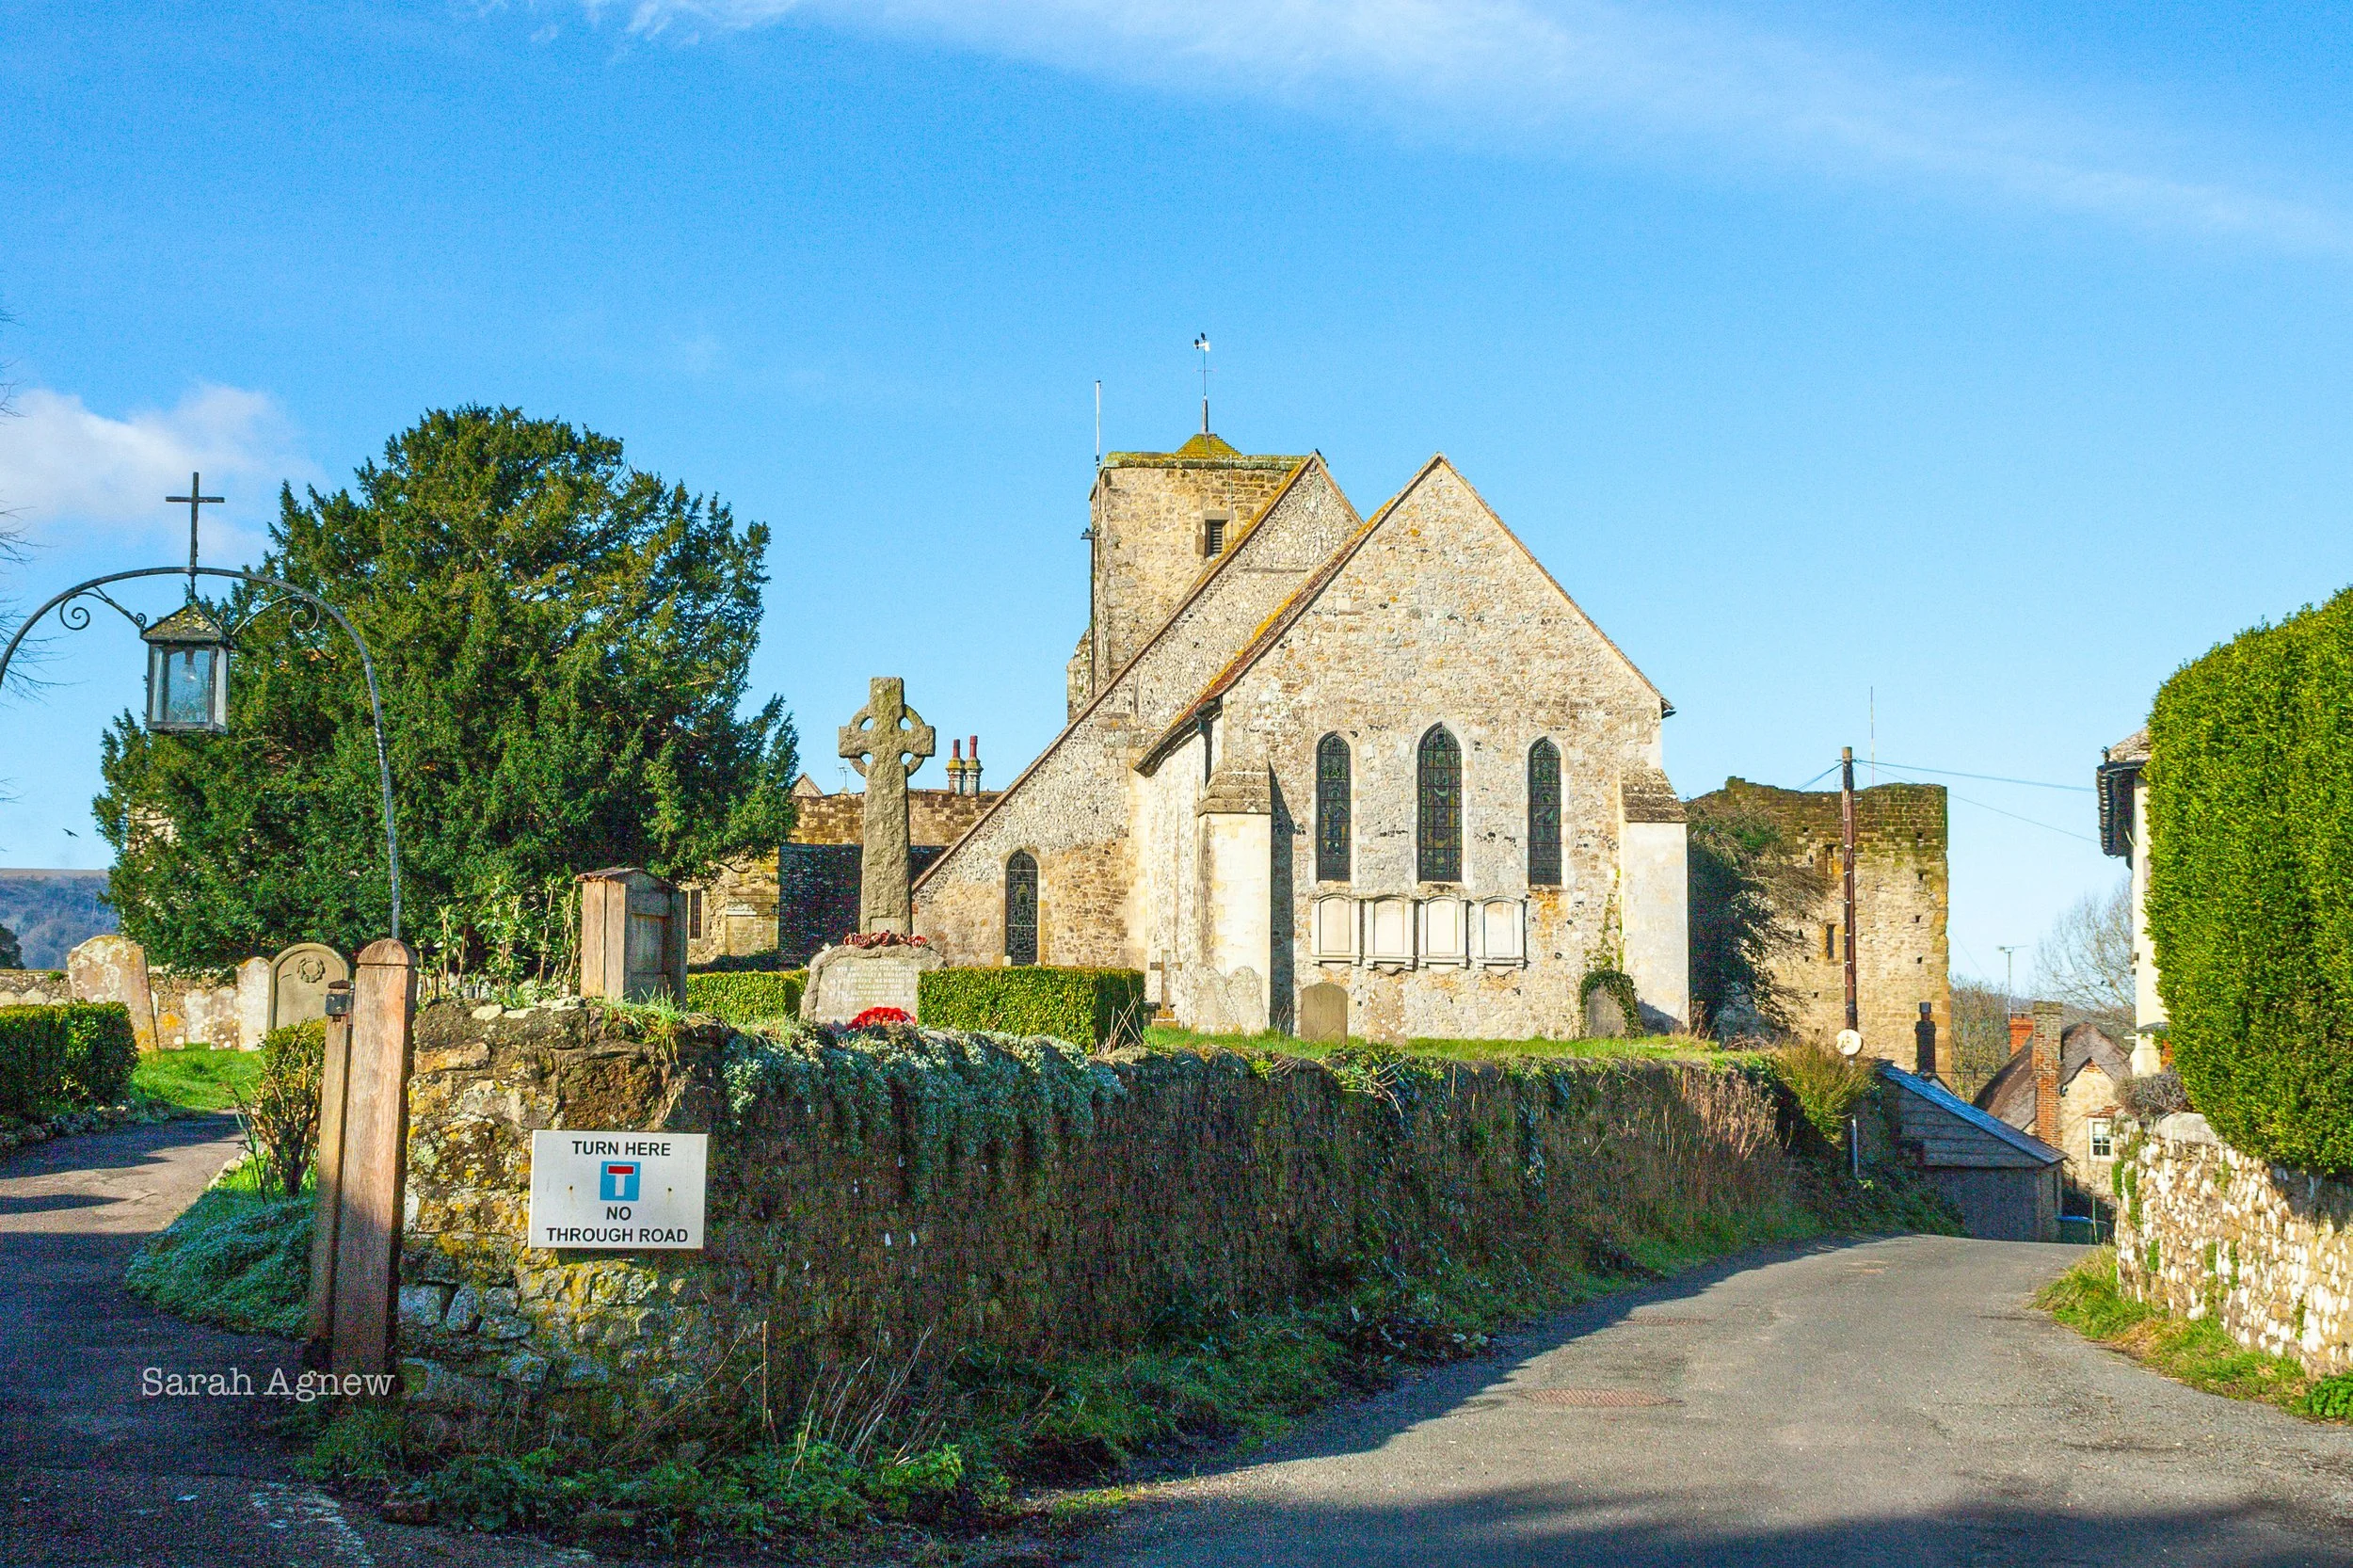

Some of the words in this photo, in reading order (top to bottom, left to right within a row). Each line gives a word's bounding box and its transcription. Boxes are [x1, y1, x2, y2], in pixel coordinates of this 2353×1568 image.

[572, 1141, 618, 1155] TURN
[625, 1142, 671, 1156] HERE
[606, 1207, 632, 1221] NO
[547, 1228, 632, 1242] THROUGH
[639, 1228, 688, 1242] ROAD
